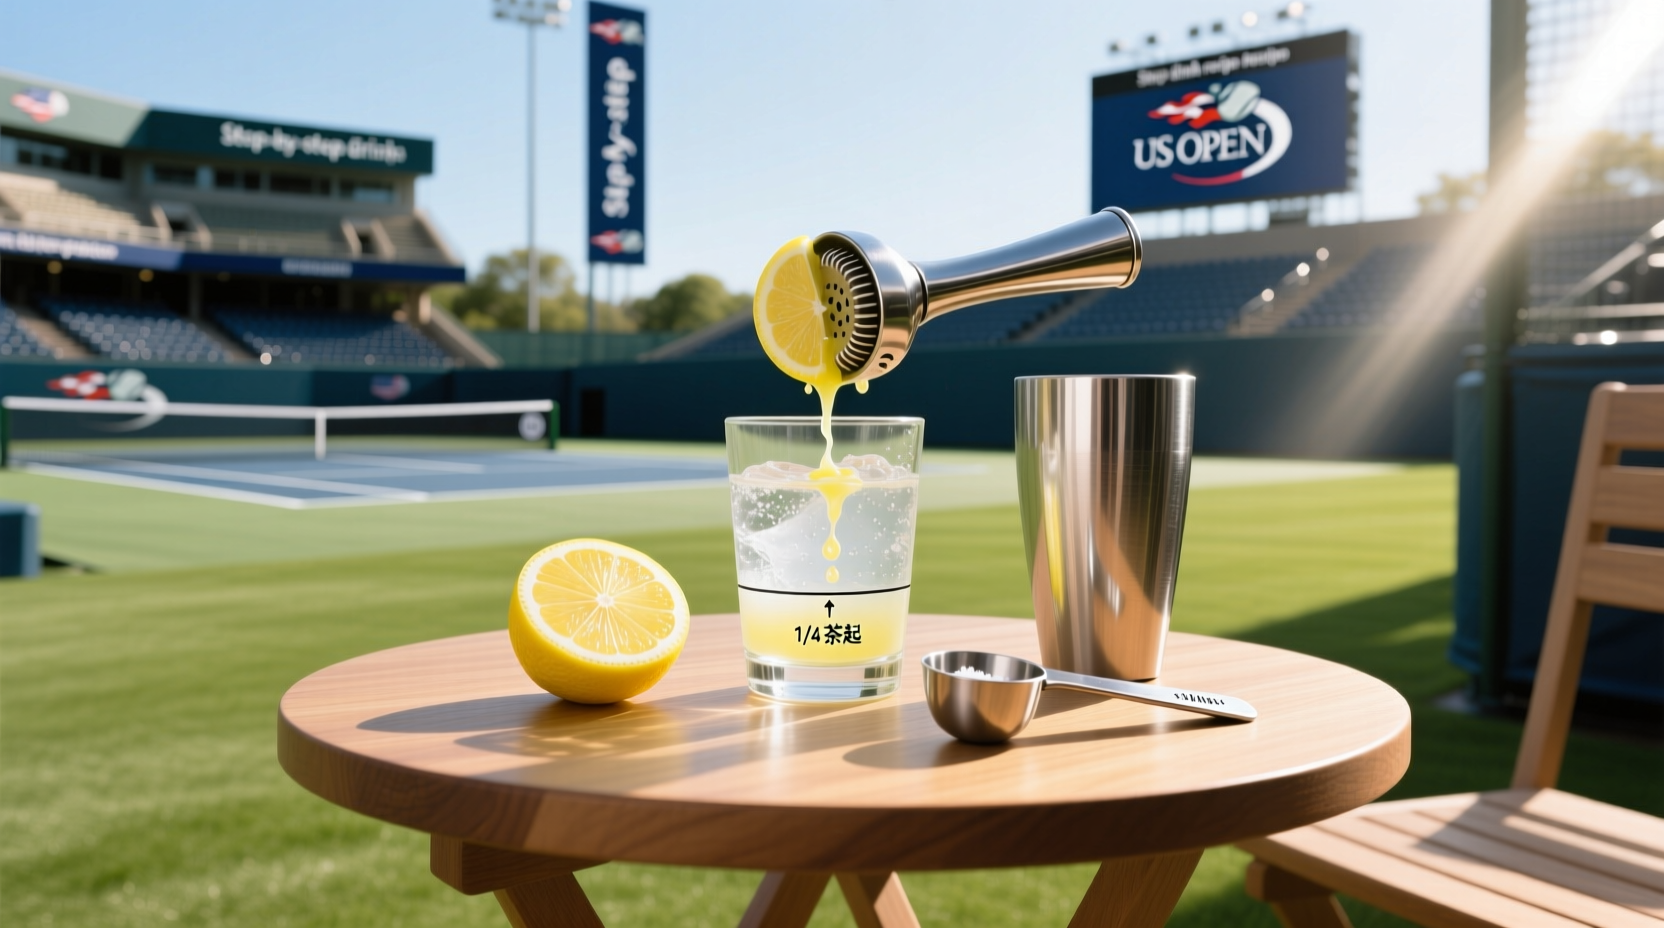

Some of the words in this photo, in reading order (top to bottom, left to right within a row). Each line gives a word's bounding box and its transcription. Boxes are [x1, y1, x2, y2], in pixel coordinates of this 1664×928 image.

[1132, 133, 1175, 171] US
[1176, 122, 1267, 166] OPEN
[794, 624, 821, 646] 1/4
